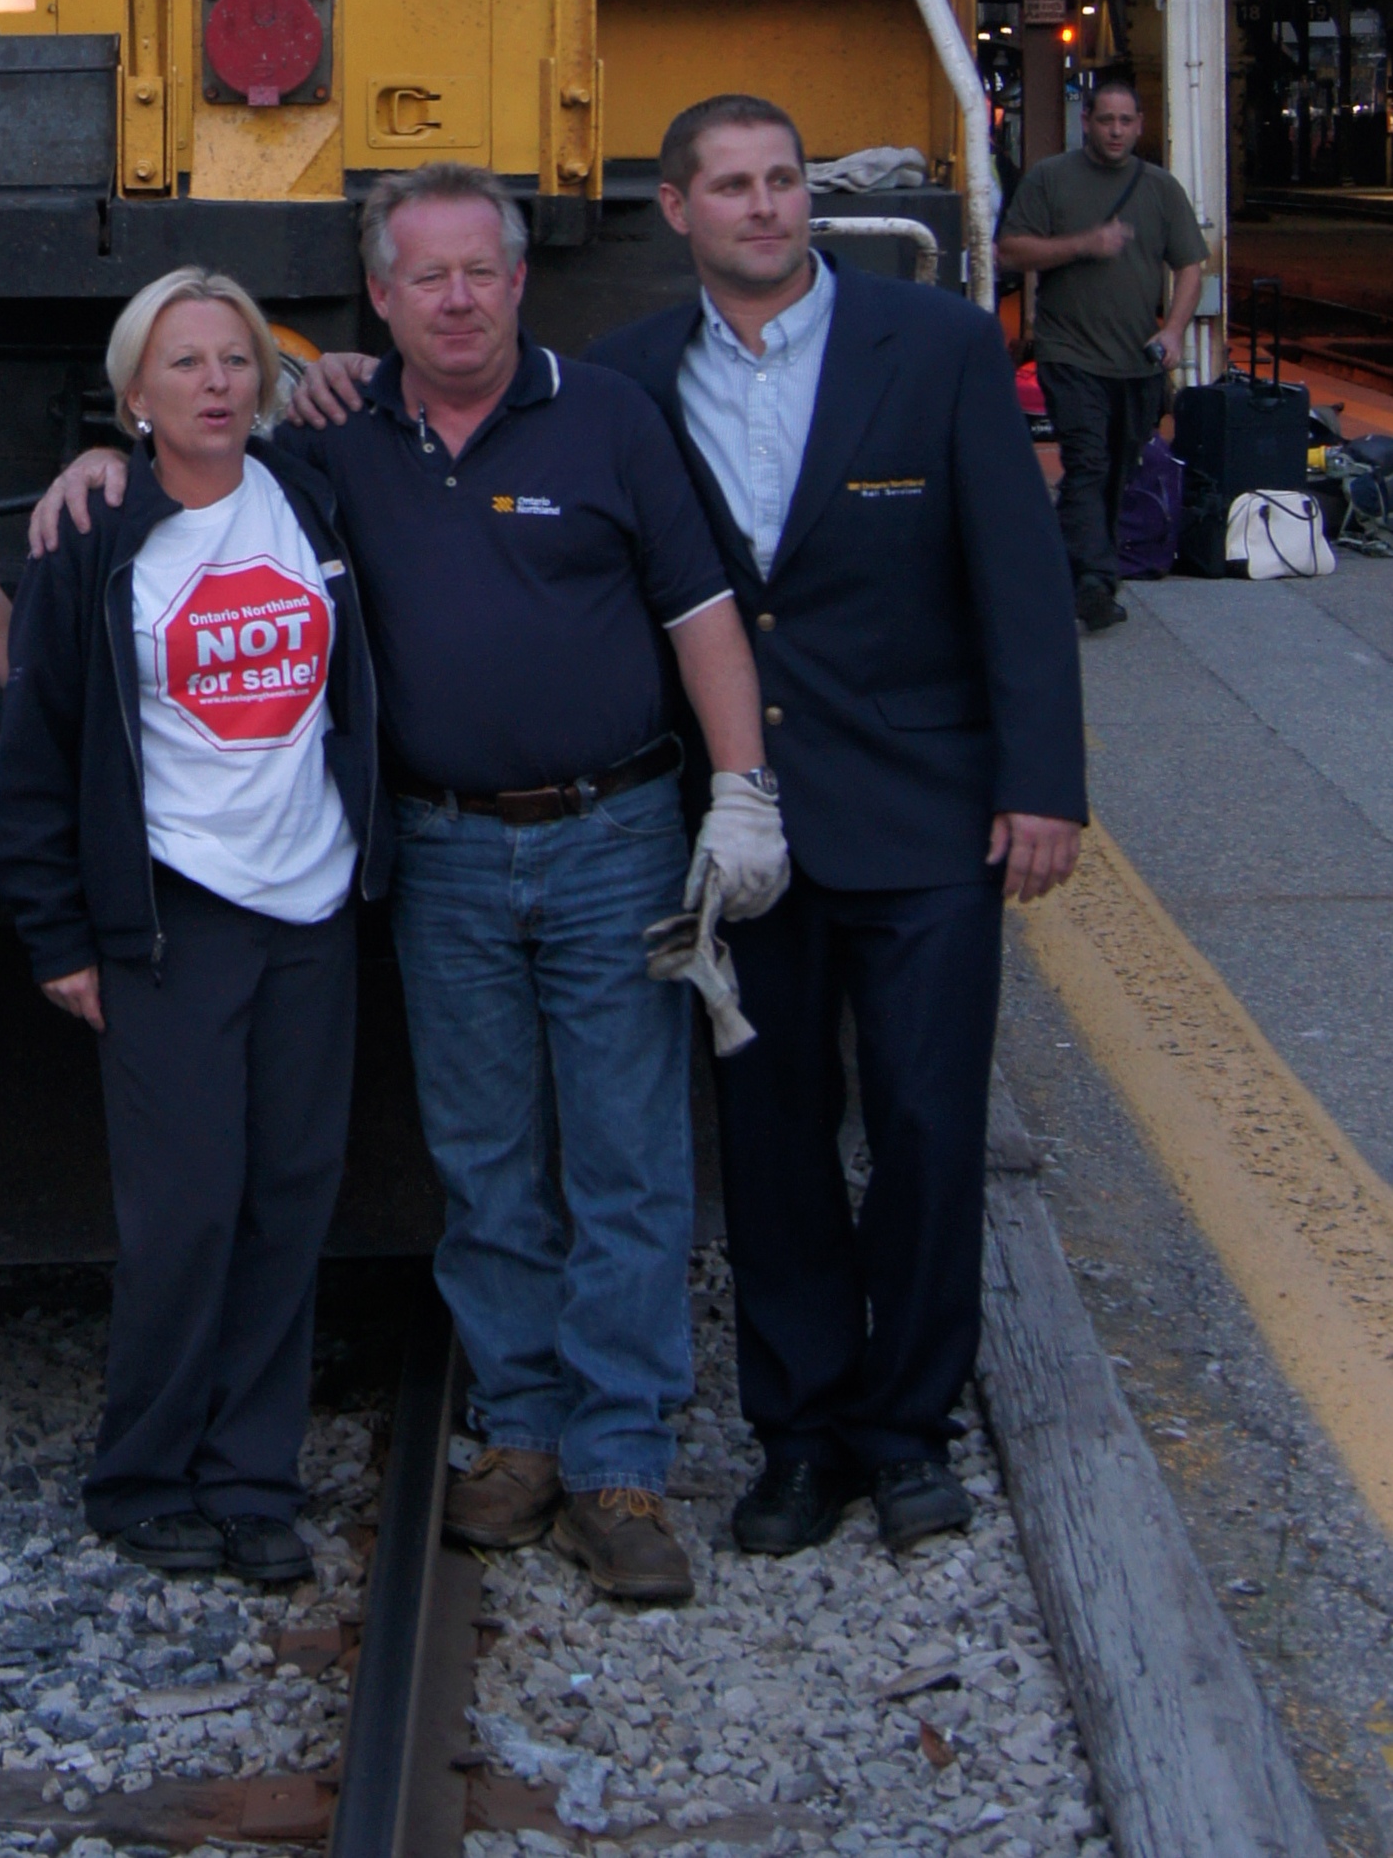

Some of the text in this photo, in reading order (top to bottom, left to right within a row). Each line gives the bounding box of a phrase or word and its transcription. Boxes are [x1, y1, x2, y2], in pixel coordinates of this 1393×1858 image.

[1241, 5, 1261, 21] 18
[1307, 4, 1327, 20] 19
[188, 594, 311, 627] Ontario Northland
[195, 612, 312, 668] NOT
[186, 654, 319, 696] for sale!
